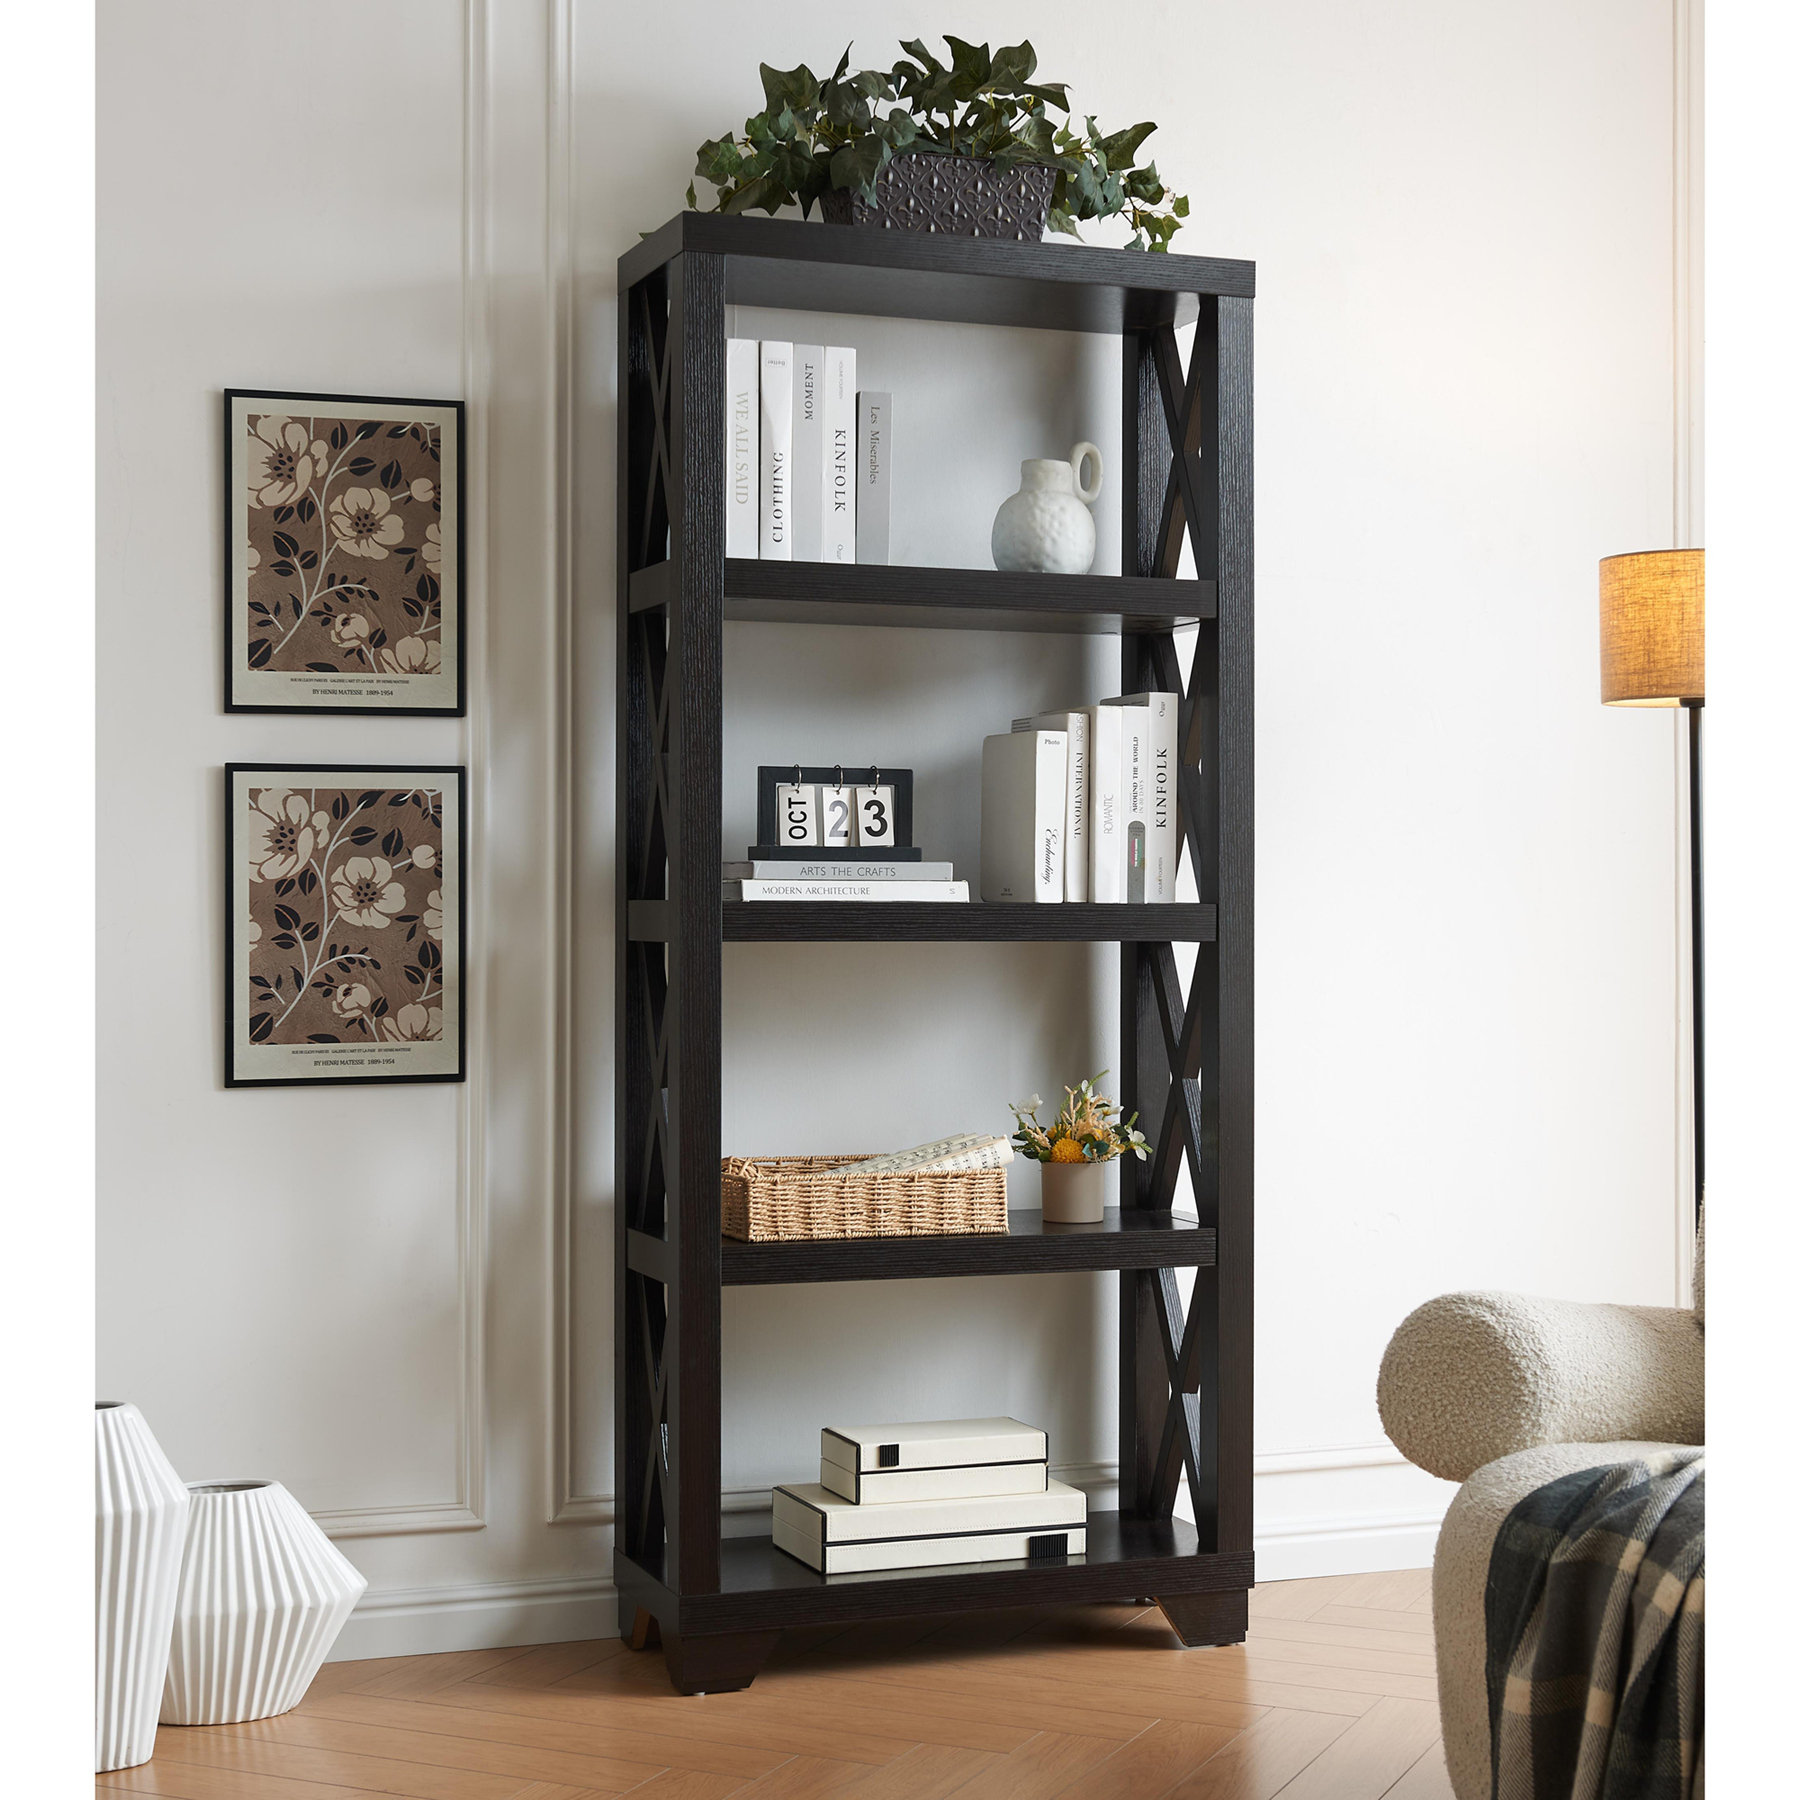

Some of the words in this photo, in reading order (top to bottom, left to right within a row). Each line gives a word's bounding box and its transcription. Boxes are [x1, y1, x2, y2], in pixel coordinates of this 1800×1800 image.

[735, 391, 749, 420] WE
[804, 363, 814, 420] MOMENT
[870, 406, 880, 424] Les
[735, 424, 749, 458] ALL
[869, 430, 880, 485] Miserables
[735, 462, 749, 504] SAID
[834, 429, 846, 512] KINFOLK
[772, 452, 784, 543] CLOTHING
[1156, 748, 1168, 828] KINFOLK
[788, 797, 807, 839] OCT
[828, 800, 848, 838] 2
[864, 800, 888, 837] 3
[1104, 793, 1113, 834] ROMANTIC
[762, 887, 802, 895] MODERN
[805, 887, 870, 895] ARCHITECTURE
[800, 867, 826, 876] ARTS
[832, 867, 852, 876] THE
[857, 867, 896, 877] CRAFTS
